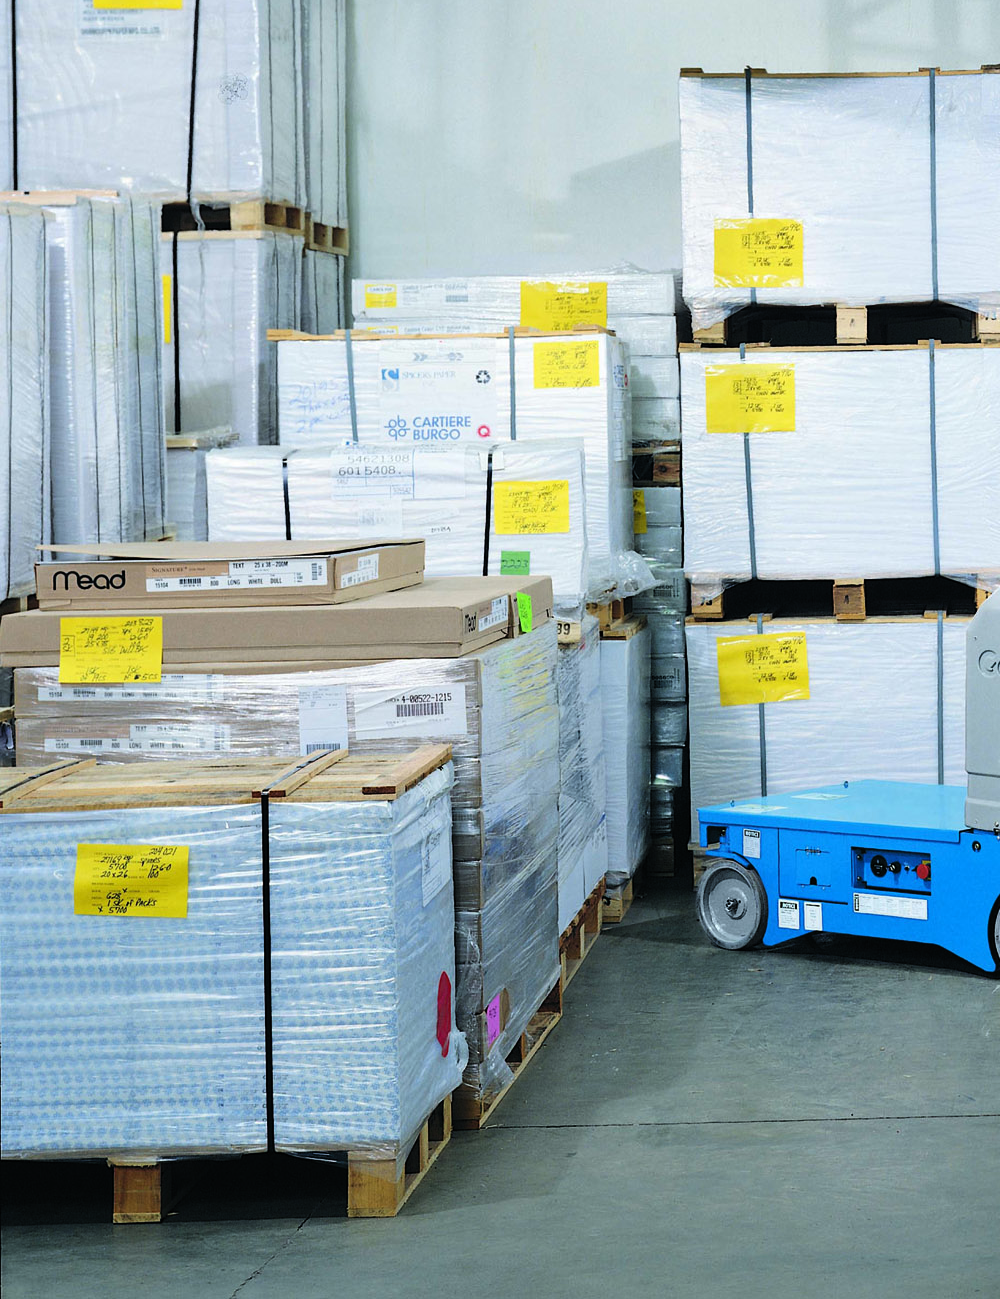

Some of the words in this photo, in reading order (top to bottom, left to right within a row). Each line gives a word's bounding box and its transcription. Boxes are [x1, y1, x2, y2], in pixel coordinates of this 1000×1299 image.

[413, 416, 471, 428] CARTIERE
[413, 428, 461, 440] BURGO
[401, 693, 452, 703] 4-00522-1215
